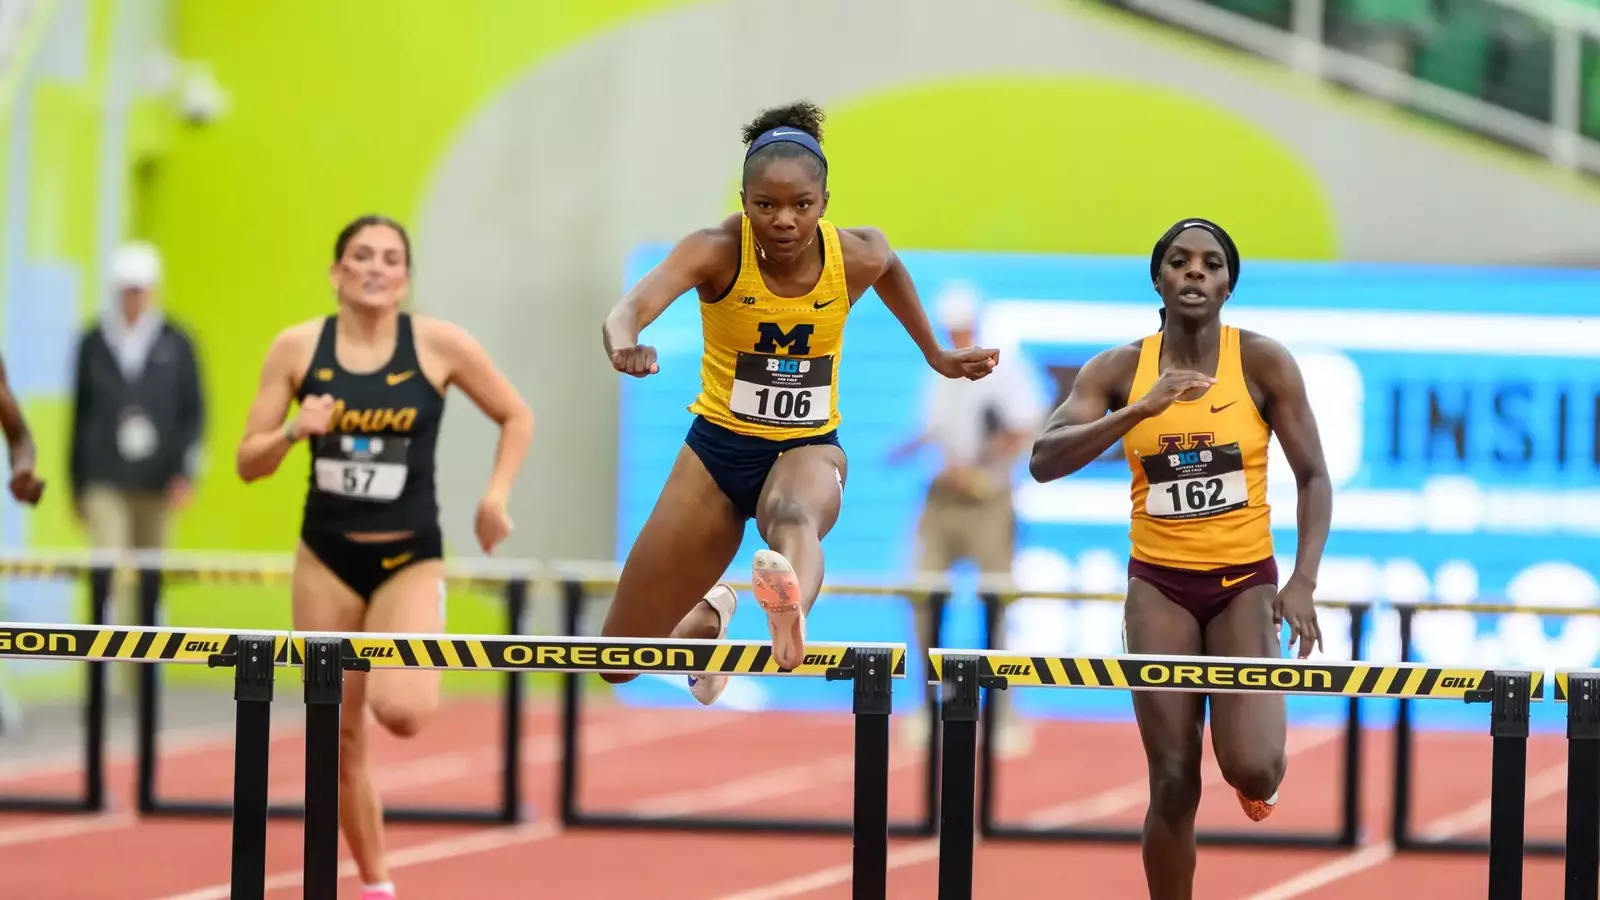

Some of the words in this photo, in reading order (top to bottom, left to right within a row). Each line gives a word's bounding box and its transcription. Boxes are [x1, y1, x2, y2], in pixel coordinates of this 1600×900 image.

[754, 322, 814, 355] M
[755, 388, 812, 418] 106
[1391, 386, 1600, 466] INSI
[343, 467, 377, 494] 57
[1166, 478, 1227, 512] 162
[185, 641, 219, 652] GILL
[360, 646, 395, 658] GILL
[503, 645, 694, 666] OREGON
[803, 654, 837, 666] GILL
[997, 664, 1032, 675] GILL
[1140, 664, 1332, 688] OREGON
[1440, 677, 1475, 688] GILL
